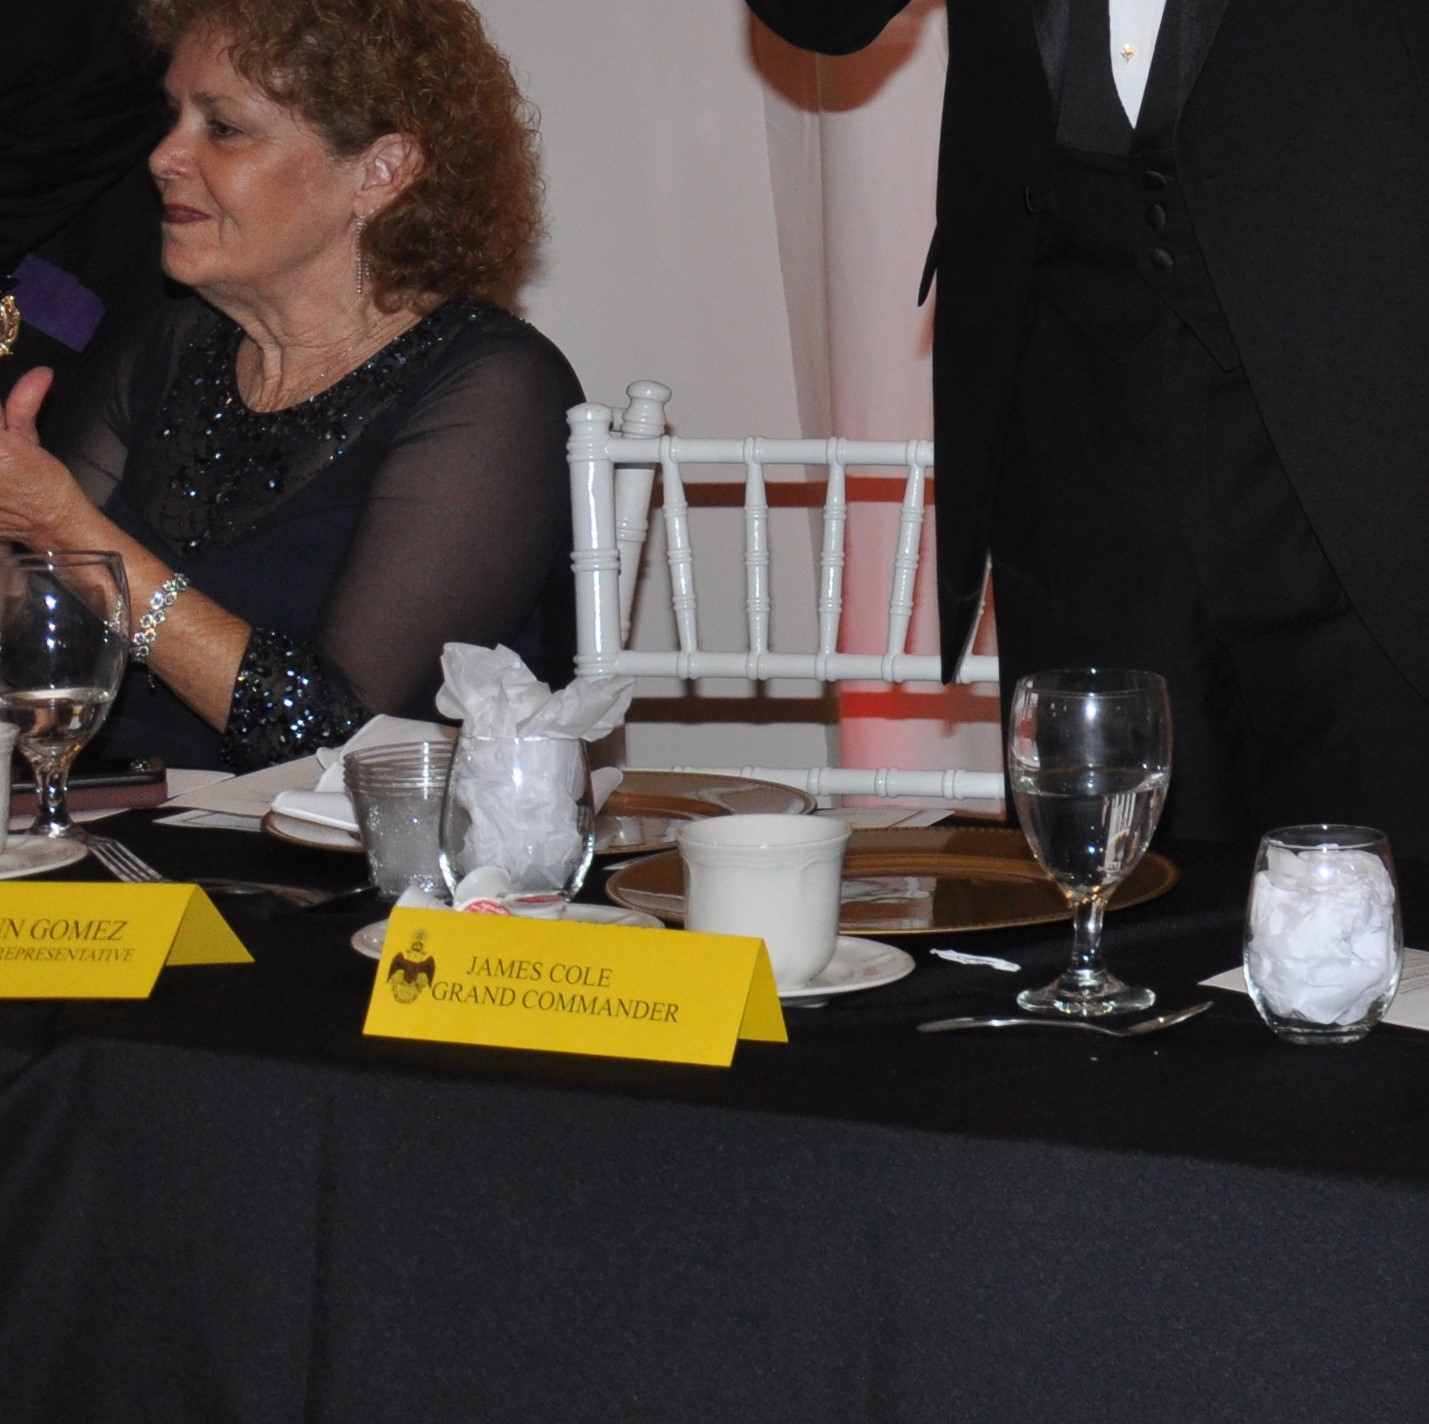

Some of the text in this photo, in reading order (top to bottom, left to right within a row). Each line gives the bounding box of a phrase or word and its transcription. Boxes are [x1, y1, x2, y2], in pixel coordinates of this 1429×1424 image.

[30, 918, 128, 941] GOMEZ
[466, 955, 613, 988] JAMES COLE
[431, 980, 680, 1023] GRAND COMMANDER
